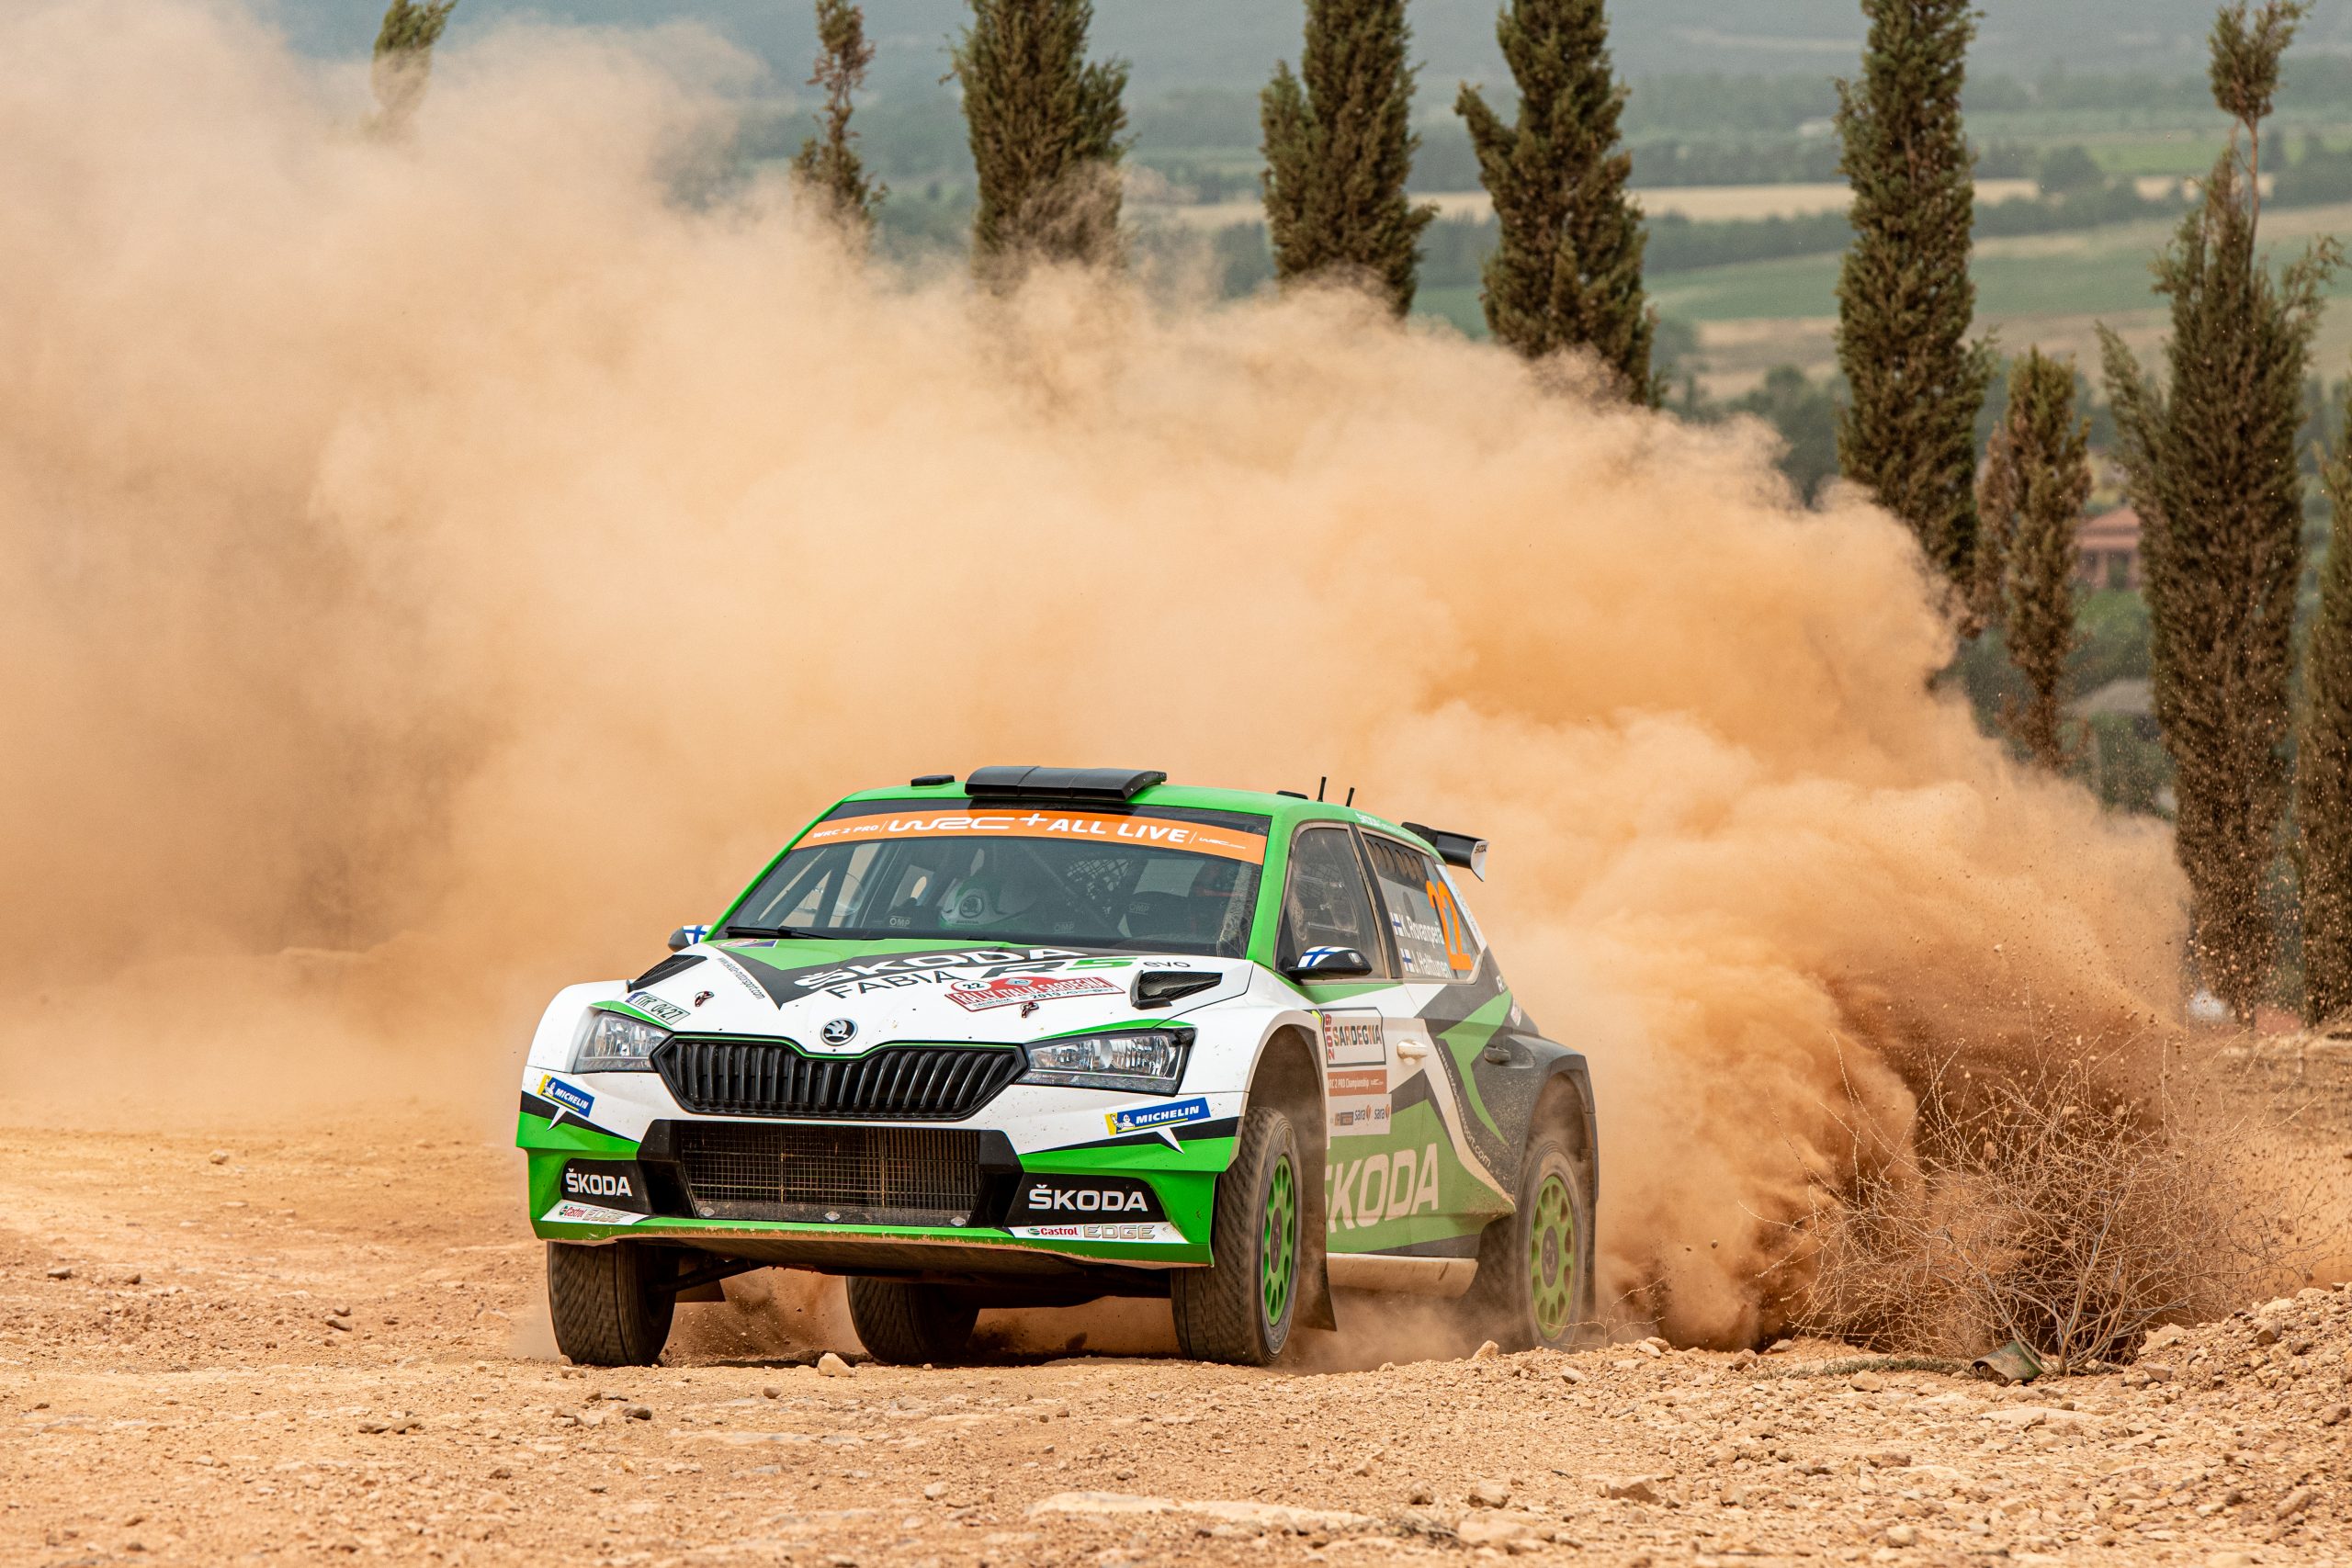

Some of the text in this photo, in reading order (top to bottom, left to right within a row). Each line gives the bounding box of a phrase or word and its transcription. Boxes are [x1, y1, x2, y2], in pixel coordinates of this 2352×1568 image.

[813, 829, 838, 839] WRC
[853, 824, 879, 833] PRO
[1046, 818, 1106, 835] ALL
[1117, 823, 1189, 843] LIVE
[889, 917, 910, 927] OMP
[794, 948, 1088, 989] ŠKODA
[825, 970, 965, 999] FABIA
[954, 976, 1114, 1006] RALLY ITALIA SARDEGNA
[1031, 991, 1061, 999] 2019
[650, 1003, 684, 1021] 0427
[1325, 1013, 1335, 1060] 2019
[1332, 1024, 1382, 1046] SARDEGNA
[554, 1088, 590, 1110] MICHELIN
[1136, 1105, 1199, 1124] MICHELIN
[1355, 1109, 1366, 1121] sara
[1374, 1108, 1385, 1120] sara
[565, 1168, 633, 1197] ŠKODA
[1028, 1184, 1148, 1212] ŠKODA
[563, 1205, 630, 1224] Castrol EDGE
[1040, 1224, 1156, 1239] Castrol EDGE
